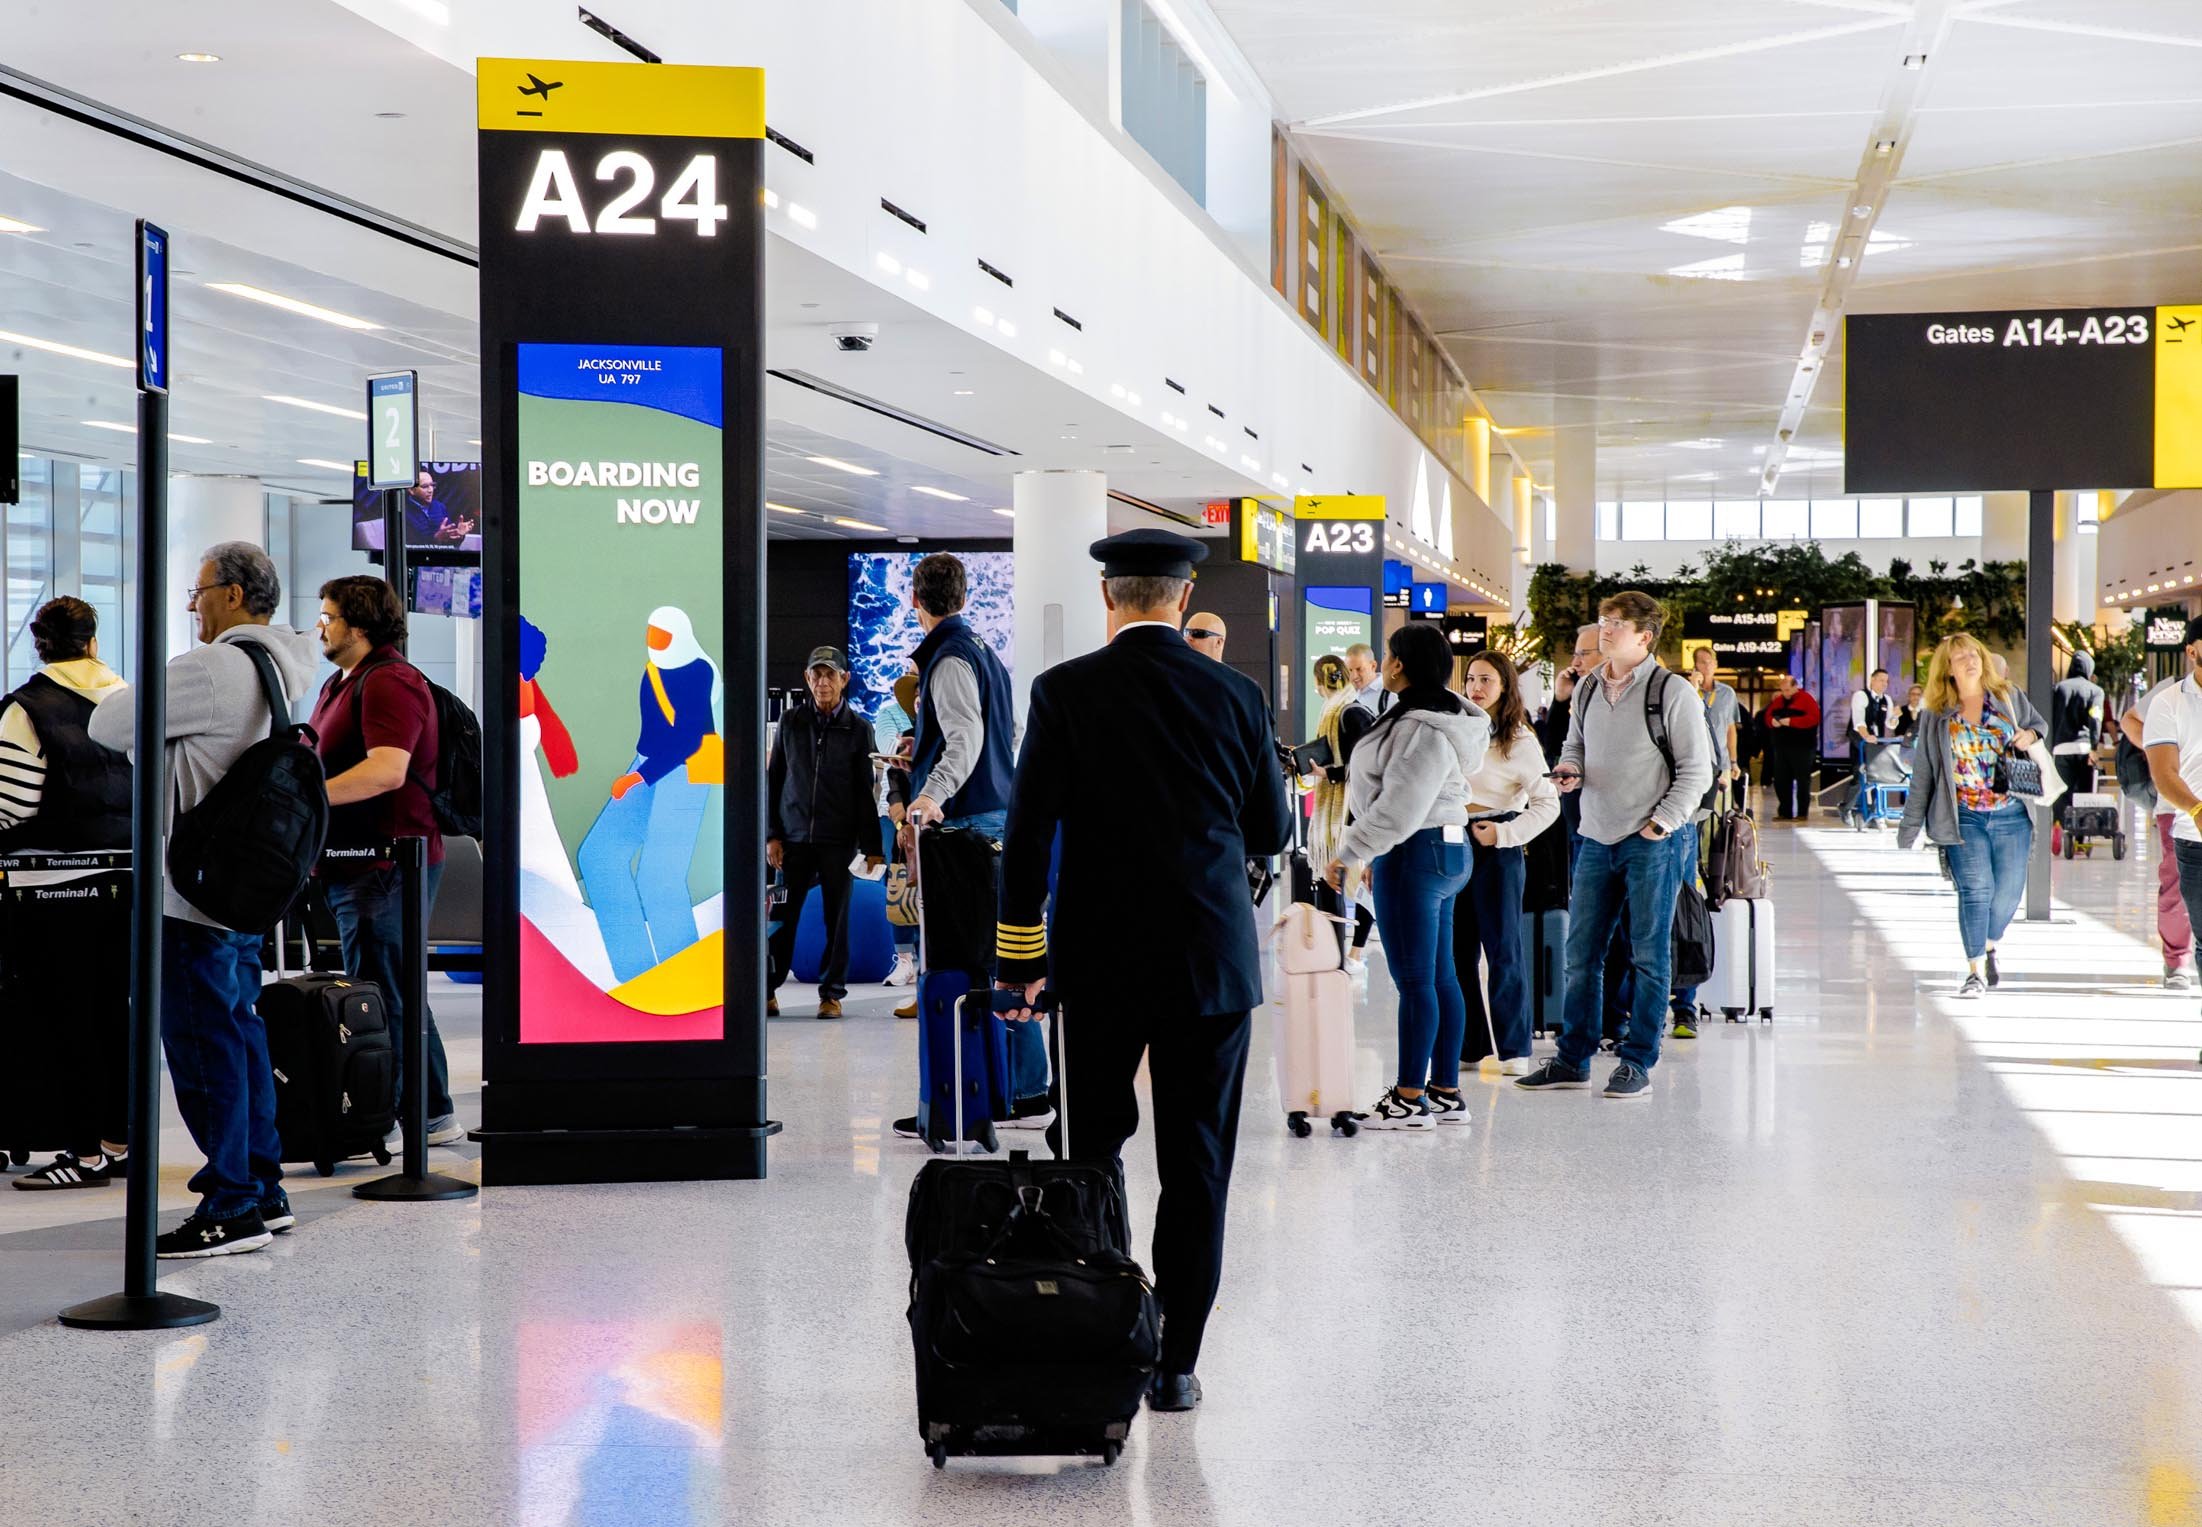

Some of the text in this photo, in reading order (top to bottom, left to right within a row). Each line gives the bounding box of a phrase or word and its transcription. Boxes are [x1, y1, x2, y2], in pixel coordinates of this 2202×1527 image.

[514, 148, 728, 237] A24
[1926, 315, 2149, 347] Gates A14-A23
[577, 359, 662, 371] JACKSONVILLE
[598, 374, 641, 384] UA 797
[385, 407, 401, 448] 2
[528, 461, 700, 487] BOARDING
[617, 499, 700, 524] NOW
[1305, 522, 1375, 553] A23
[2154, 617, 2186, 631] New
[46, 857, 90, 866] Terminal
[90, 857, 99, 865] A
[325, 848, 376, 857] Terminal A
[35, 887, 99, 899] Terminal A
